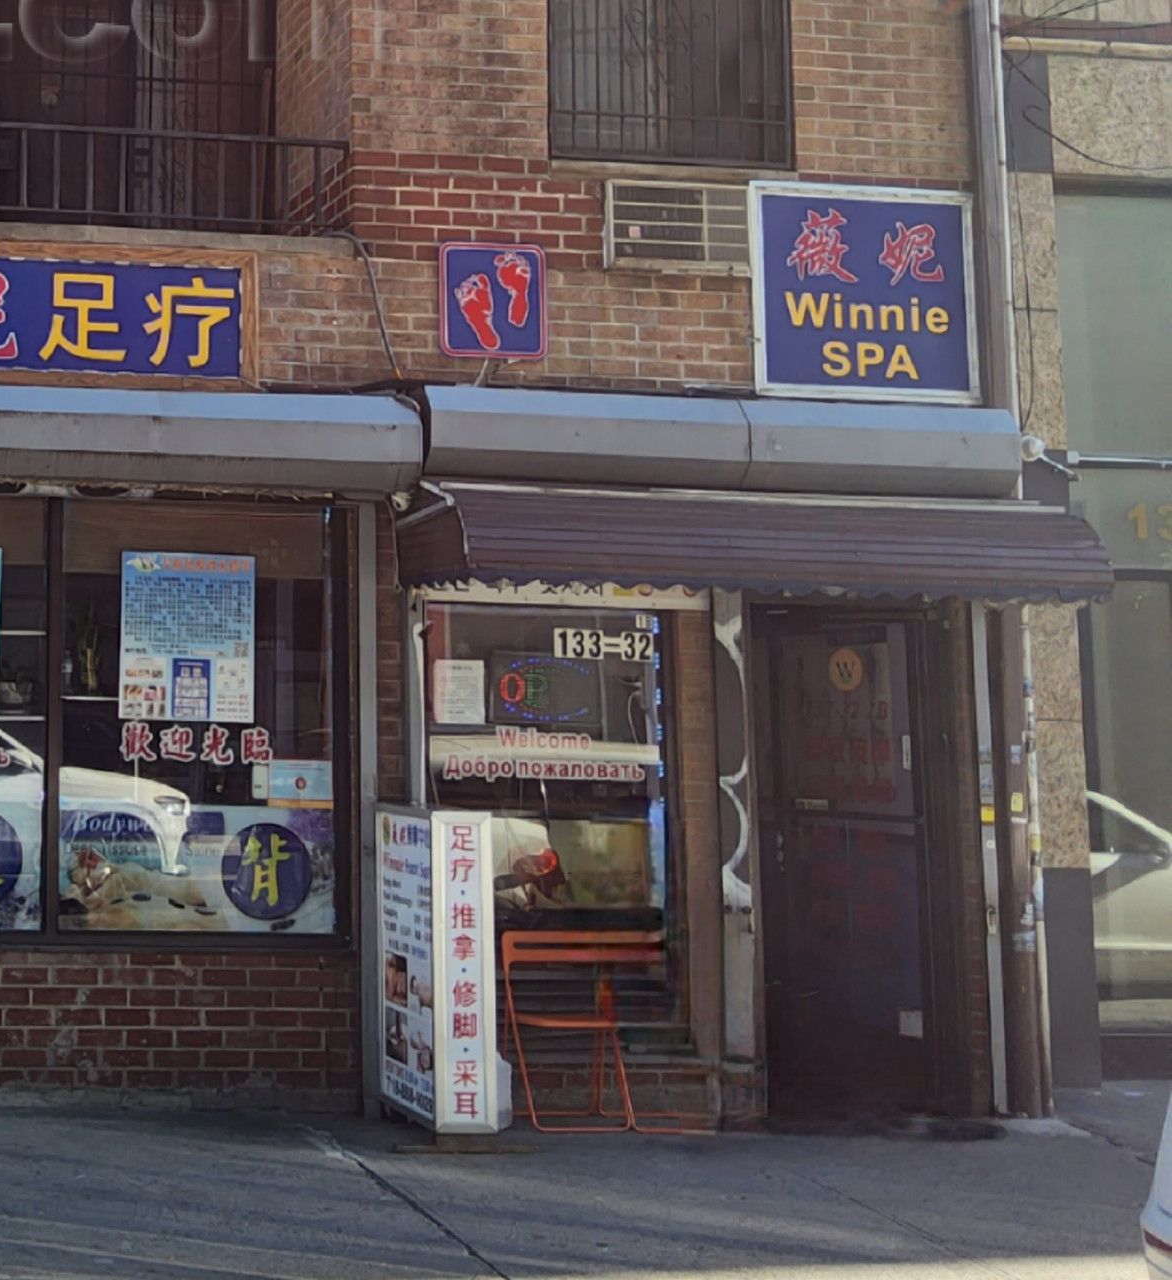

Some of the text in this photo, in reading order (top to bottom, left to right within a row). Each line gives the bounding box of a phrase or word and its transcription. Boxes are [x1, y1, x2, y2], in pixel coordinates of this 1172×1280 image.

[787, 208, 944, 286] 薇妮
[784, 290, 950, 333] Winnie
[822, 341, 919, 380] SPA
[557, 631, 651, 660] 133-32
[499, 727, 591, 749] Welcome
[446, 754, 644, 780] Добро пожаловать
